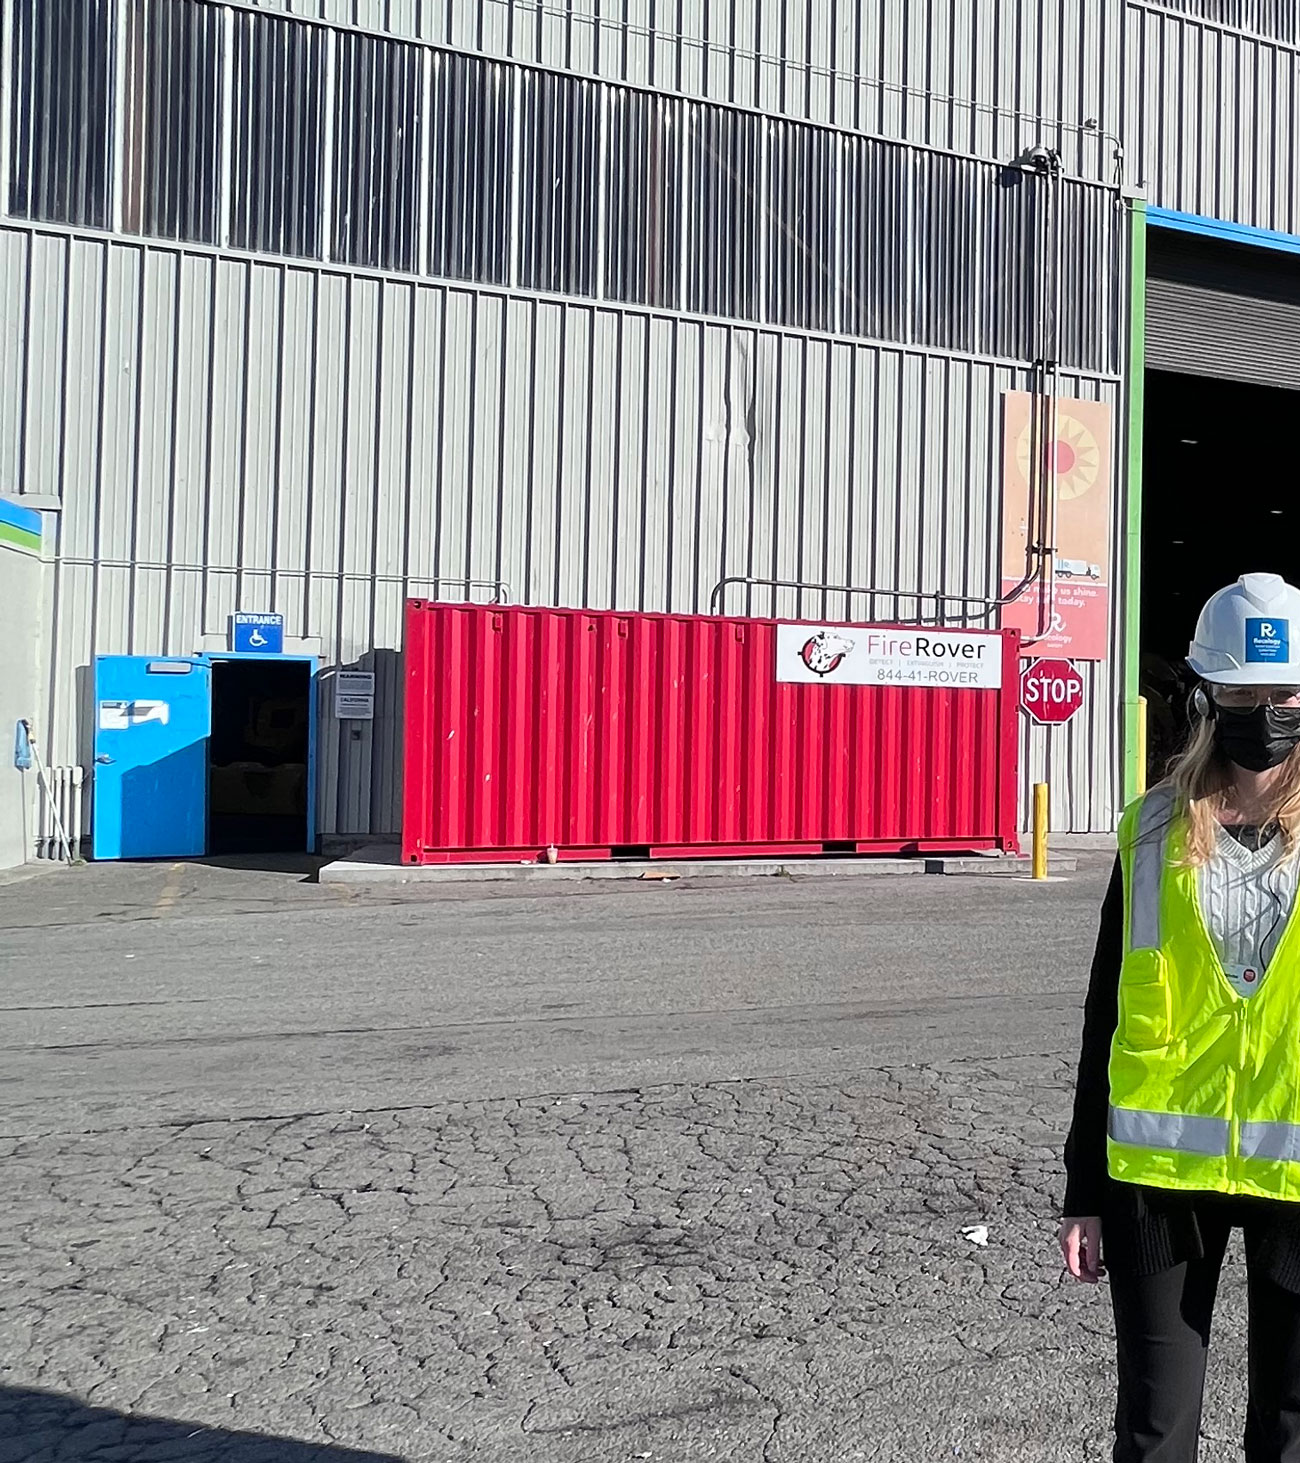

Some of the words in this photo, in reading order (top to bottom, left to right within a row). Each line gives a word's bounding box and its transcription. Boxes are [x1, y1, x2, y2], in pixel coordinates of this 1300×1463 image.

[236, 615, 282, 625] ENTRANCE
[868, 634, 986, 660] FireRover
[877, 668, 979, 683] 844-41-ROVER
[1025, 677, 1081, 703] STOP
